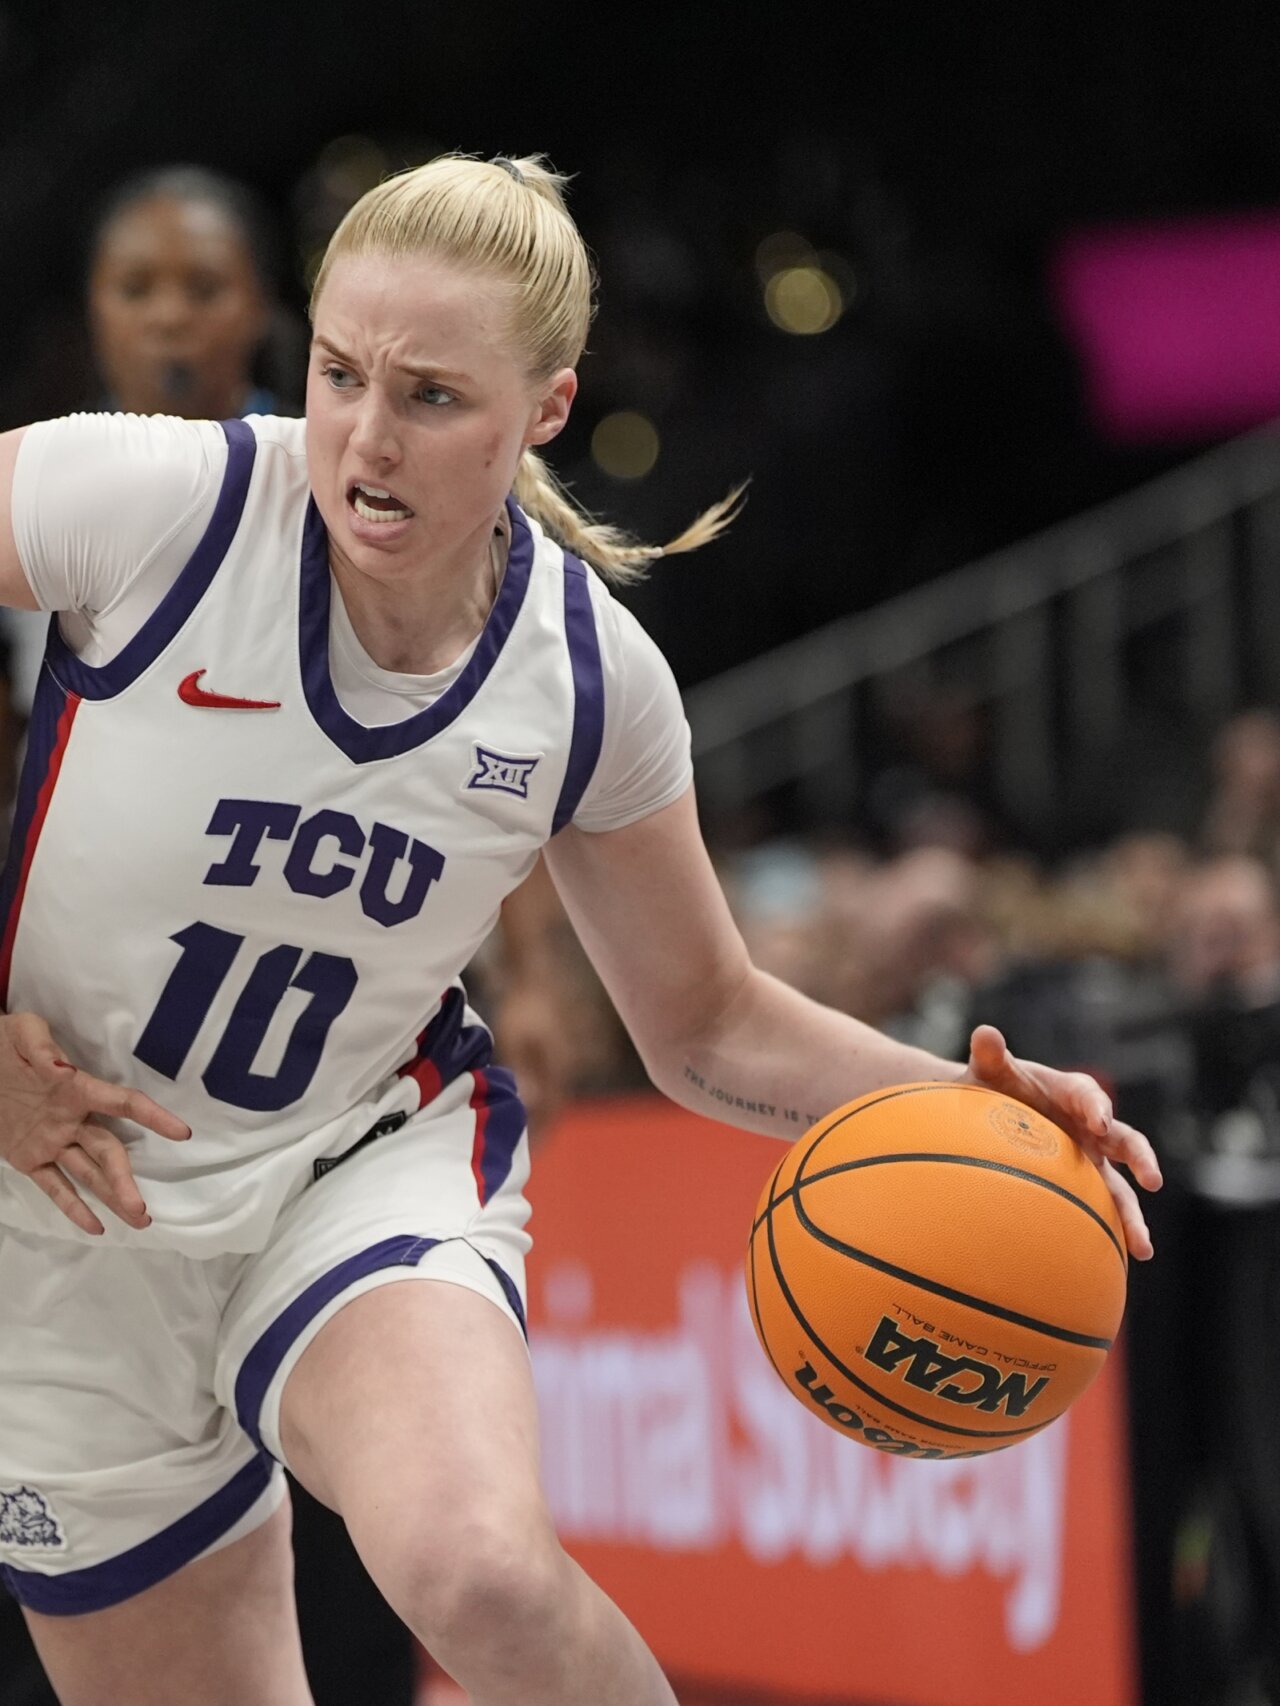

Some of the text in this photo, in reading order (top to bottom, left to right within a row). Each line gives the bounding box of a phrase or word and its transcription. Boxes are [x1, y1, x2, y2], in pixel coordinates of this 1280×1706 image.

[202, 799, 446, 928] TCU
[132, 920, 359, 1112] 10
[684, 1065, 706, 1090] THE
[708, 1087, 777, 1117] JOURNEY
[784, 1109, 799, 1123] IS
[863, 1313, 1051, 1418] NCAA
[891, 1302, 1057, 1372] OFFICIAL GAME BALL
